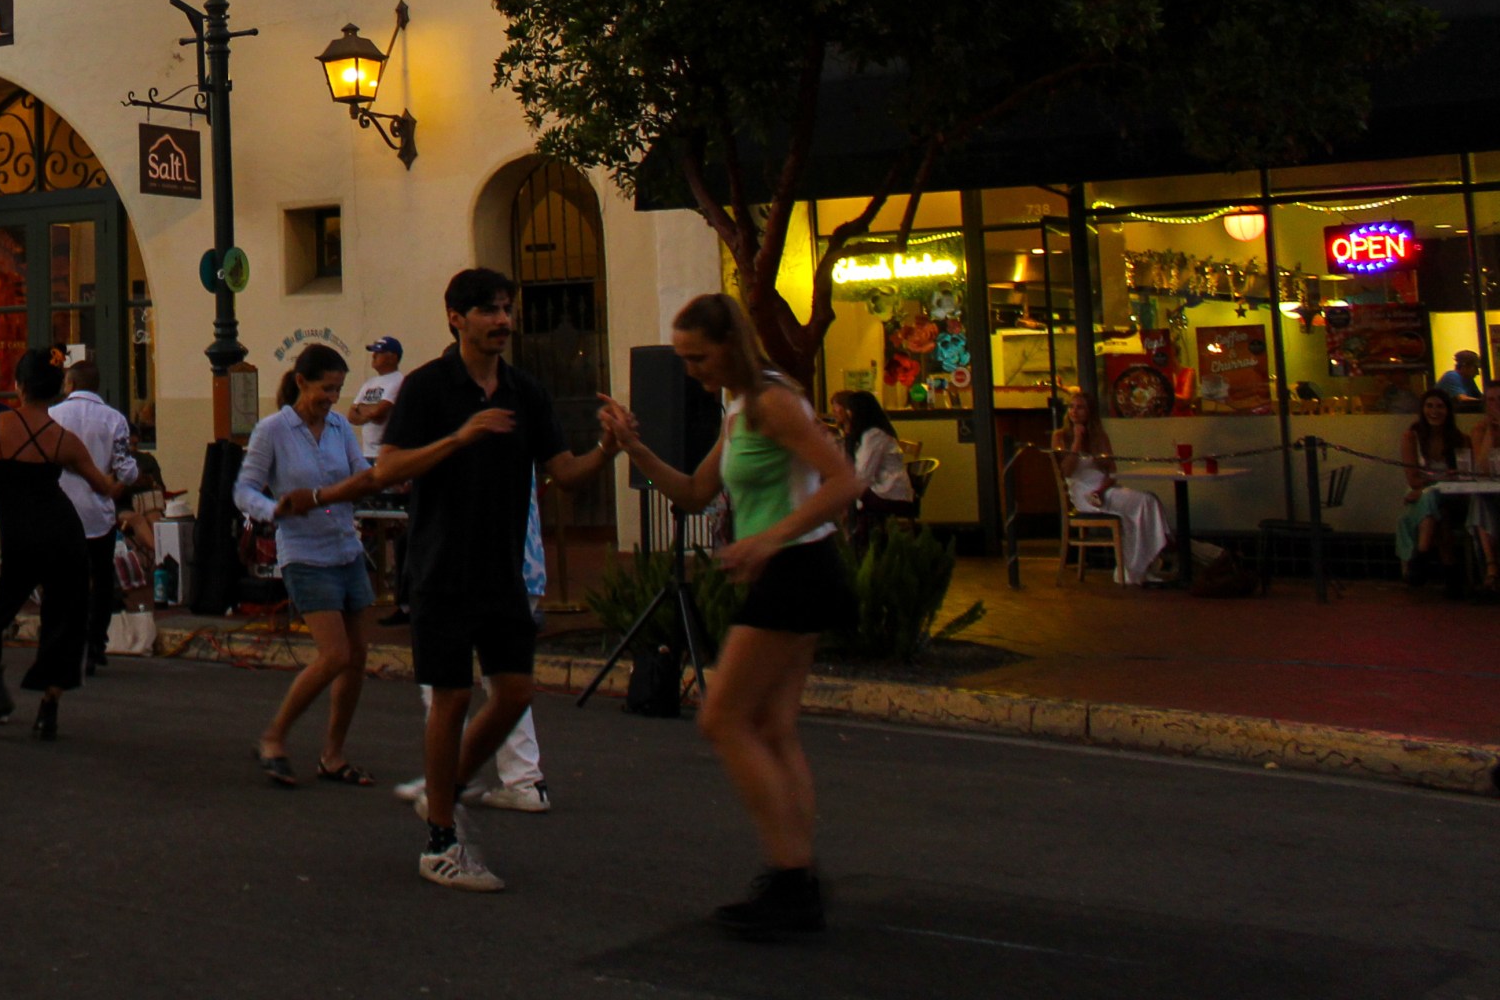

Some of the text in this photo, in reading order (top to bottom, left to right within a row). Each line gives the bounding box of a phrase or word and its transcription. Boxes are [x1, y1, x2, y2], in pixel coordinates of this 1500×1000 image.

[148, 153, 183, 181] Salt
[1026, 203, 1051, 215] 738
[1332, 235, 1405, 261] OPEN
[1211, 358, 1259, 372] Churros
